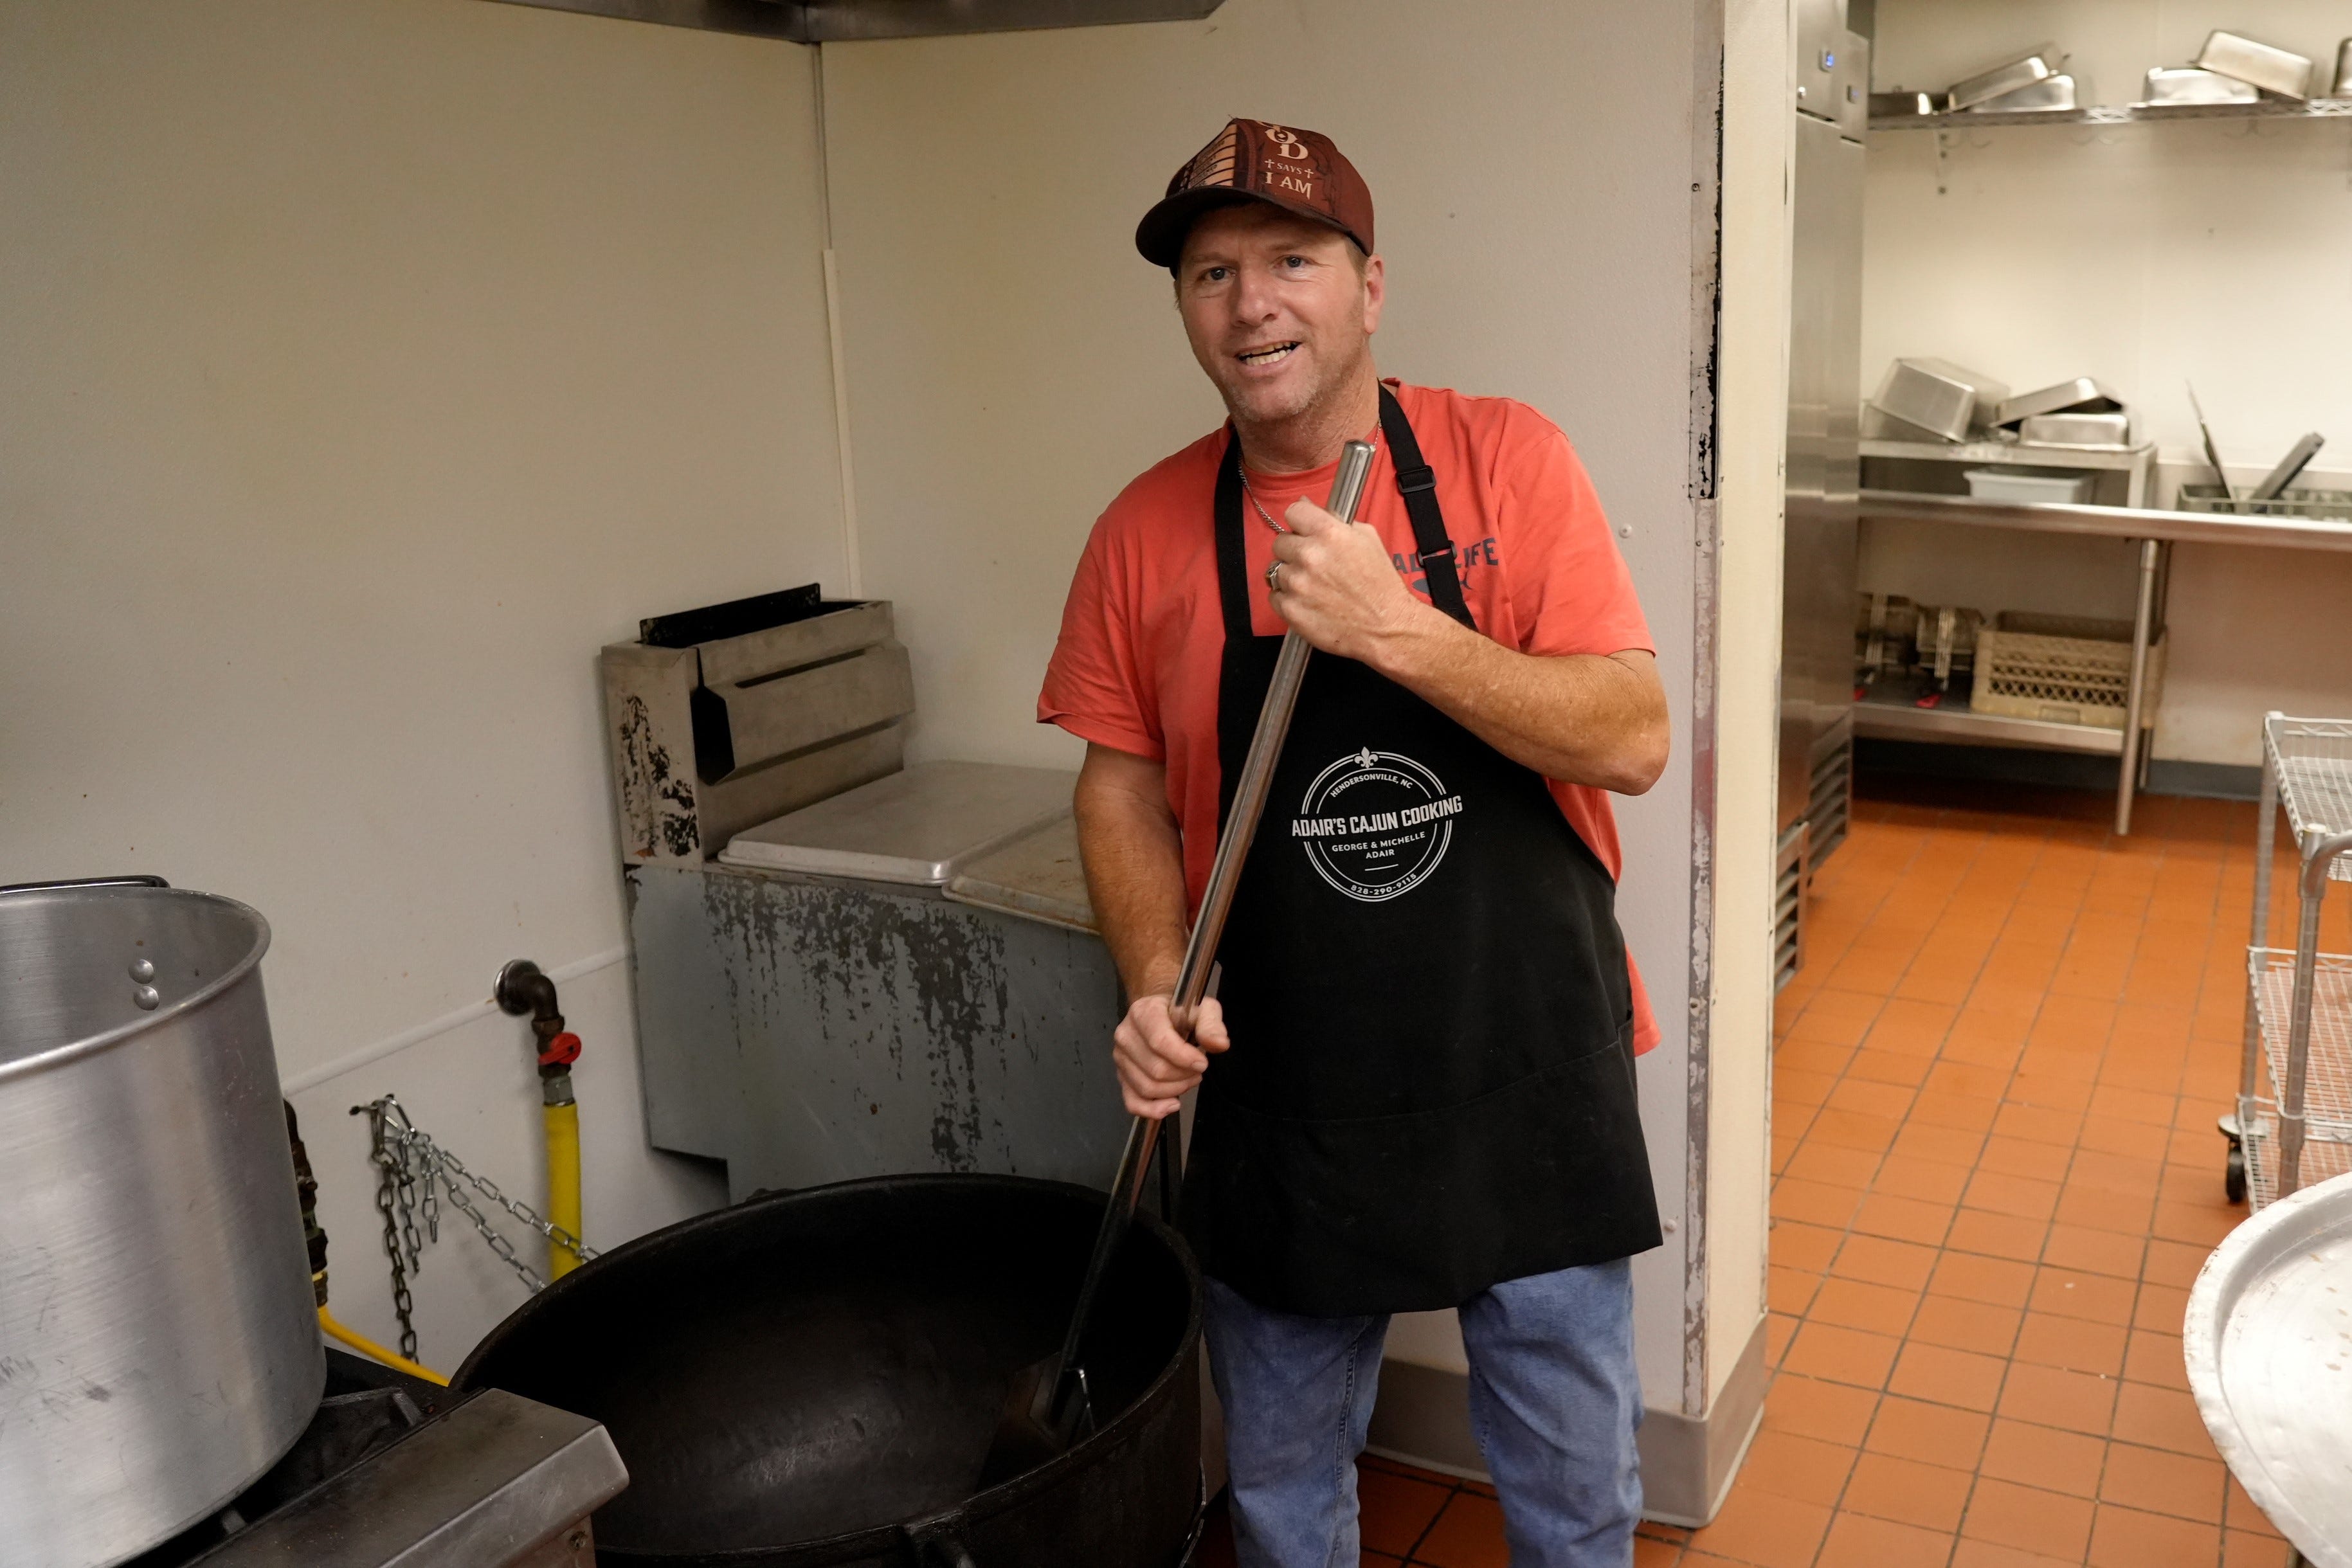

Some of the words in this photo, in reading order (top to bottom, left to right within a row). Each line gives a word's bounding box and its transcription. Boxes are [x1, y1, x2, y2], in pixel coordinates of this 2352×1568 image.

[1276, 163, 1302, 175] SAYS
[1265, 172, 1273, 185] I
[1279, 176, 1312, 200] AM
[1330, 773, 1398, 798] HENDERSONVILLE,
[1400, 779, 1413, 789] NC
[1292, 818, 1347, 836] ADAIR'S
[1350, 811, 1398, 834] CAJUN
[1401, 795, 1463, 827] COOKING
[1332, 842, 1368, 852] GEORGE
[1371, 841, 1378, 849] &
[1380, 831, 1425, 848] MICHELLE
[1366, 849, 1395, 859] ADAIR
[1351, 873, 1416, 895] 828-290-9115
